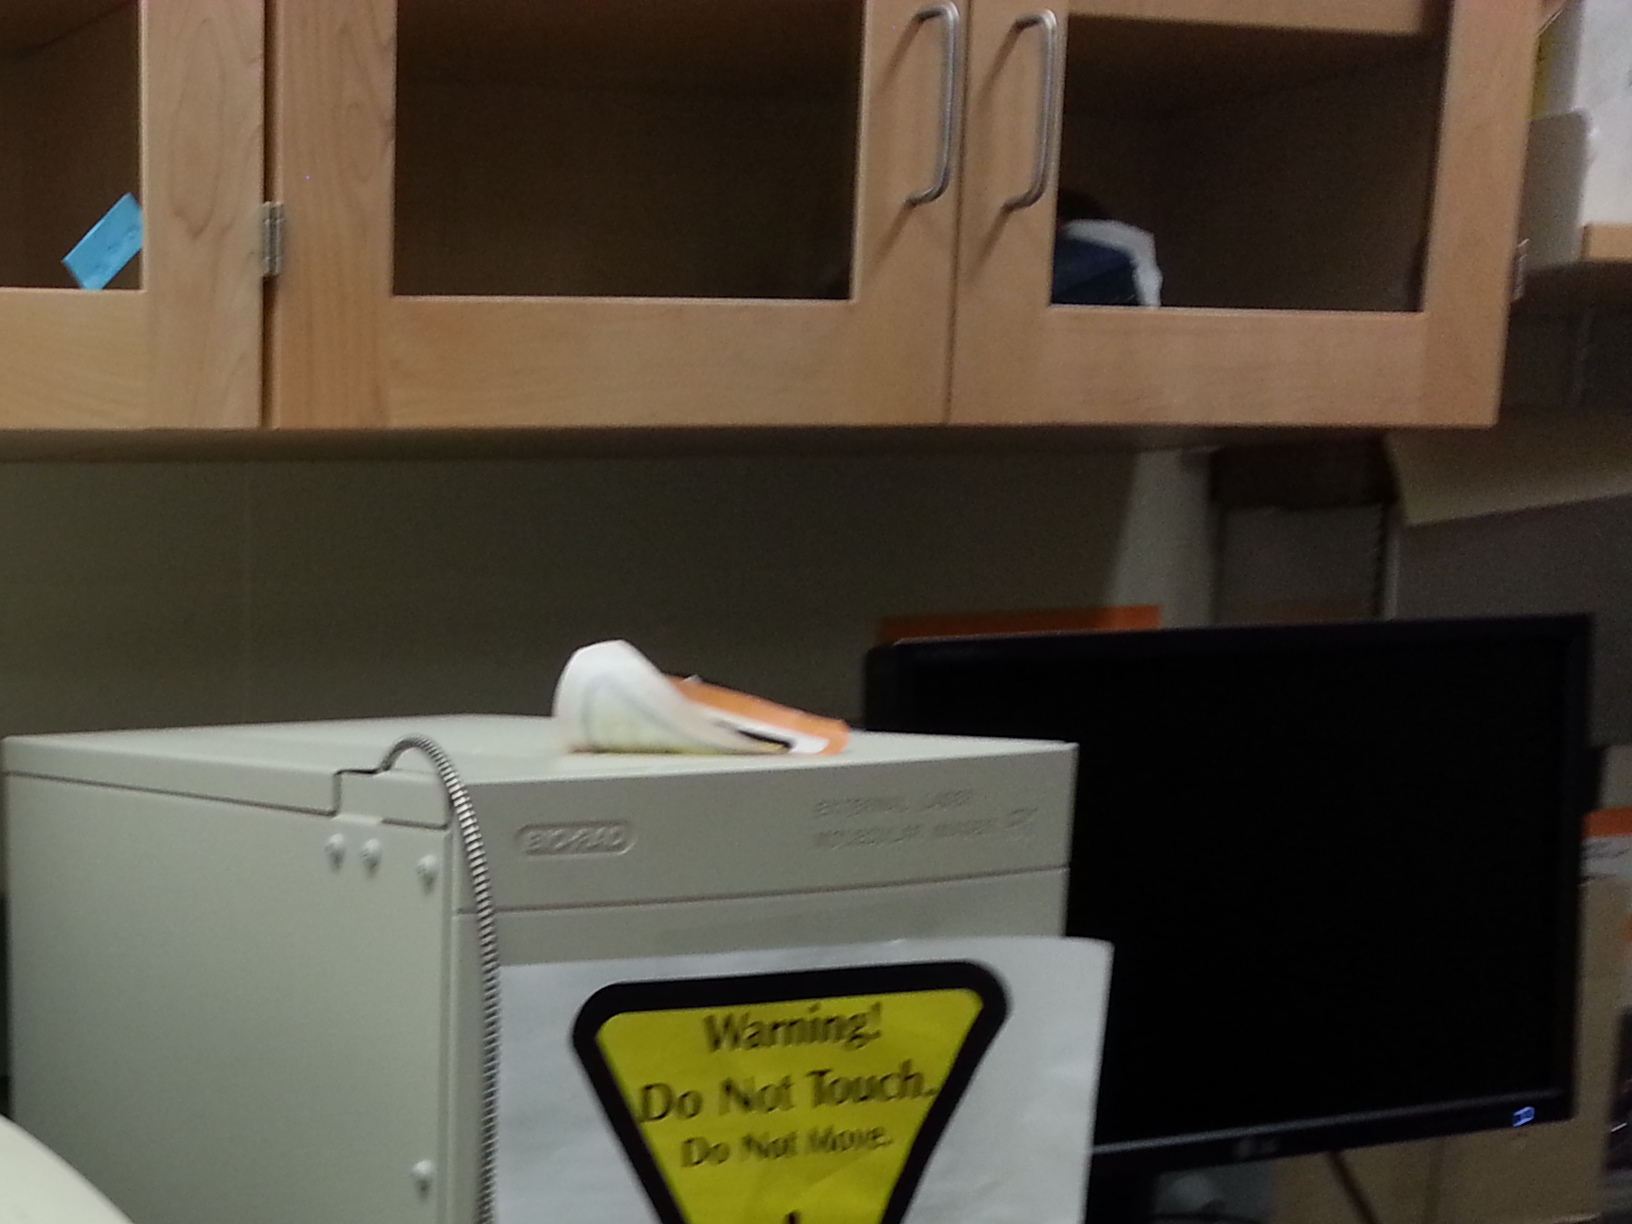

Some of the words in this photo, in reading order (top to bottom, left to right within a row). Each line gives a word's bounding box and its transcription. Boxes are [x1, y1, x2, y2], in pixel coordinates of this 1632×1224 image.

[702, 1001, 882, 1053] Warning!
[638, 1082, 704, 1123] Do
[719, 1074, 796, 1115] Not
[805, 1058, 940, 1109] Touch.
[680, 1136, 731, 1168] Do
[741, 1129, 799, 1161] Not
